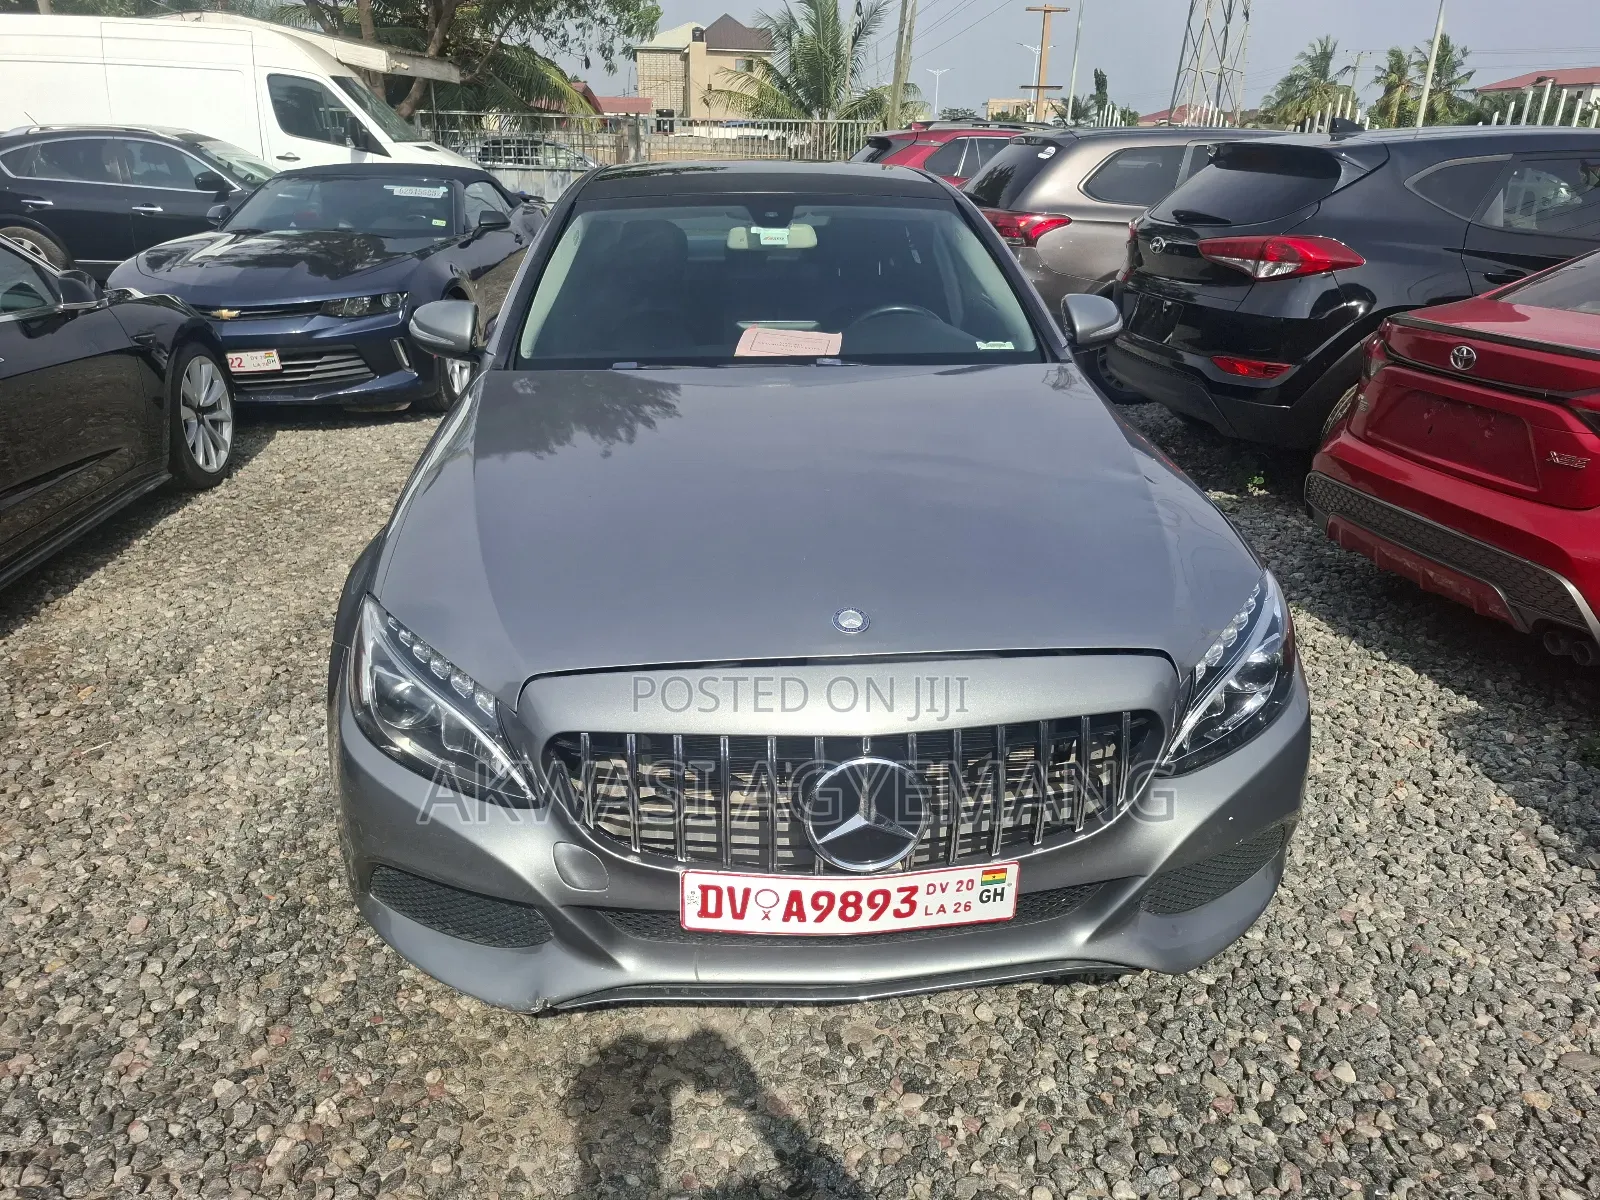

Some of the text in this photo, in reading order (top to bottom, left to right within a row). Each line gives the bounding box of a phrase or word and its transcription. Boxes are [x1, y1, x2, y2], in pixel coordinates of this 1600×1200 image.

[926, 879, 975, 896] DV 20
[978, 887, 1005, 904] GH
[697, 884, 752, 920] DV
[782, 885, 919, 923] A9893
[924, 901, 972, 917] LA 26
